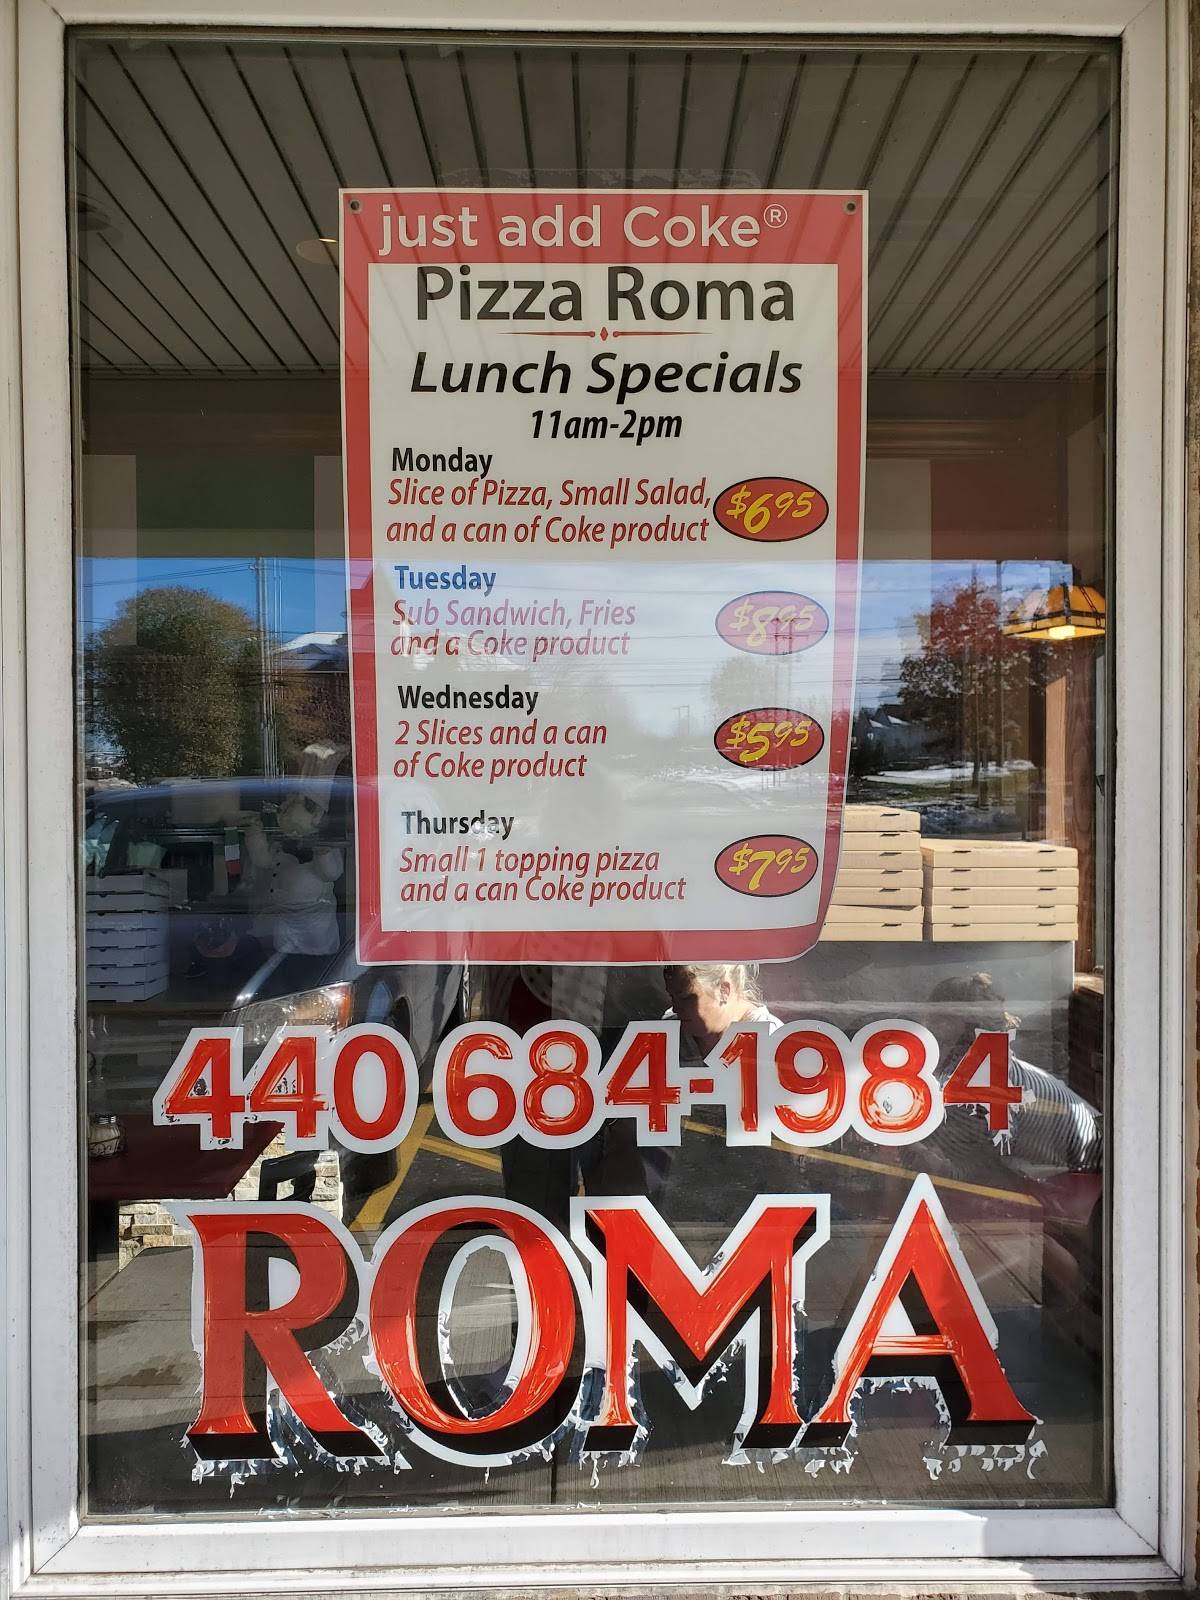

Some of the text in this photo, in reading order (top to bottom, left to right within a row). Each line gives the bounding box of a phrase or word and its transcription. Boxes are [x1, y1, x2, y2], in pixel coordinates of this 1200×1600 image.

[379, 204, 478, 255] just
[499, 205, 600, 247] add
[416, 265, 794, 321] Pizza Roma
[410, 350, 803, 405] Lunch Specials
[530, 409, 683, 446] 11am-2pm
[391, 447, 493, 479] Monday
[388, 477, 711, 510] Slice of Pizza, Small Salad,
[386, 515, 709, 548] and a can of Coke product
[394, 565, 496, 596] Tuesday
[392, 599, 636, 630] Sub Sandwich, Fries
[390, 629, 630, 662] and a Coke product
[398, 685, 539, 715] Wednesday
[395, 718, 607, 745] 2 Slices and a can
[393, 752, 587, 784] of Coke product
[401, 811, 514, 841] Thursday
[399, 847, 660, 878] Small 1 topping pizza
[400, 875, 687, 907] and a can Coke product
[161, 1028, 1025, 1145] 440 684-1984
[186, 1198, 1038, 1456] ROMA
